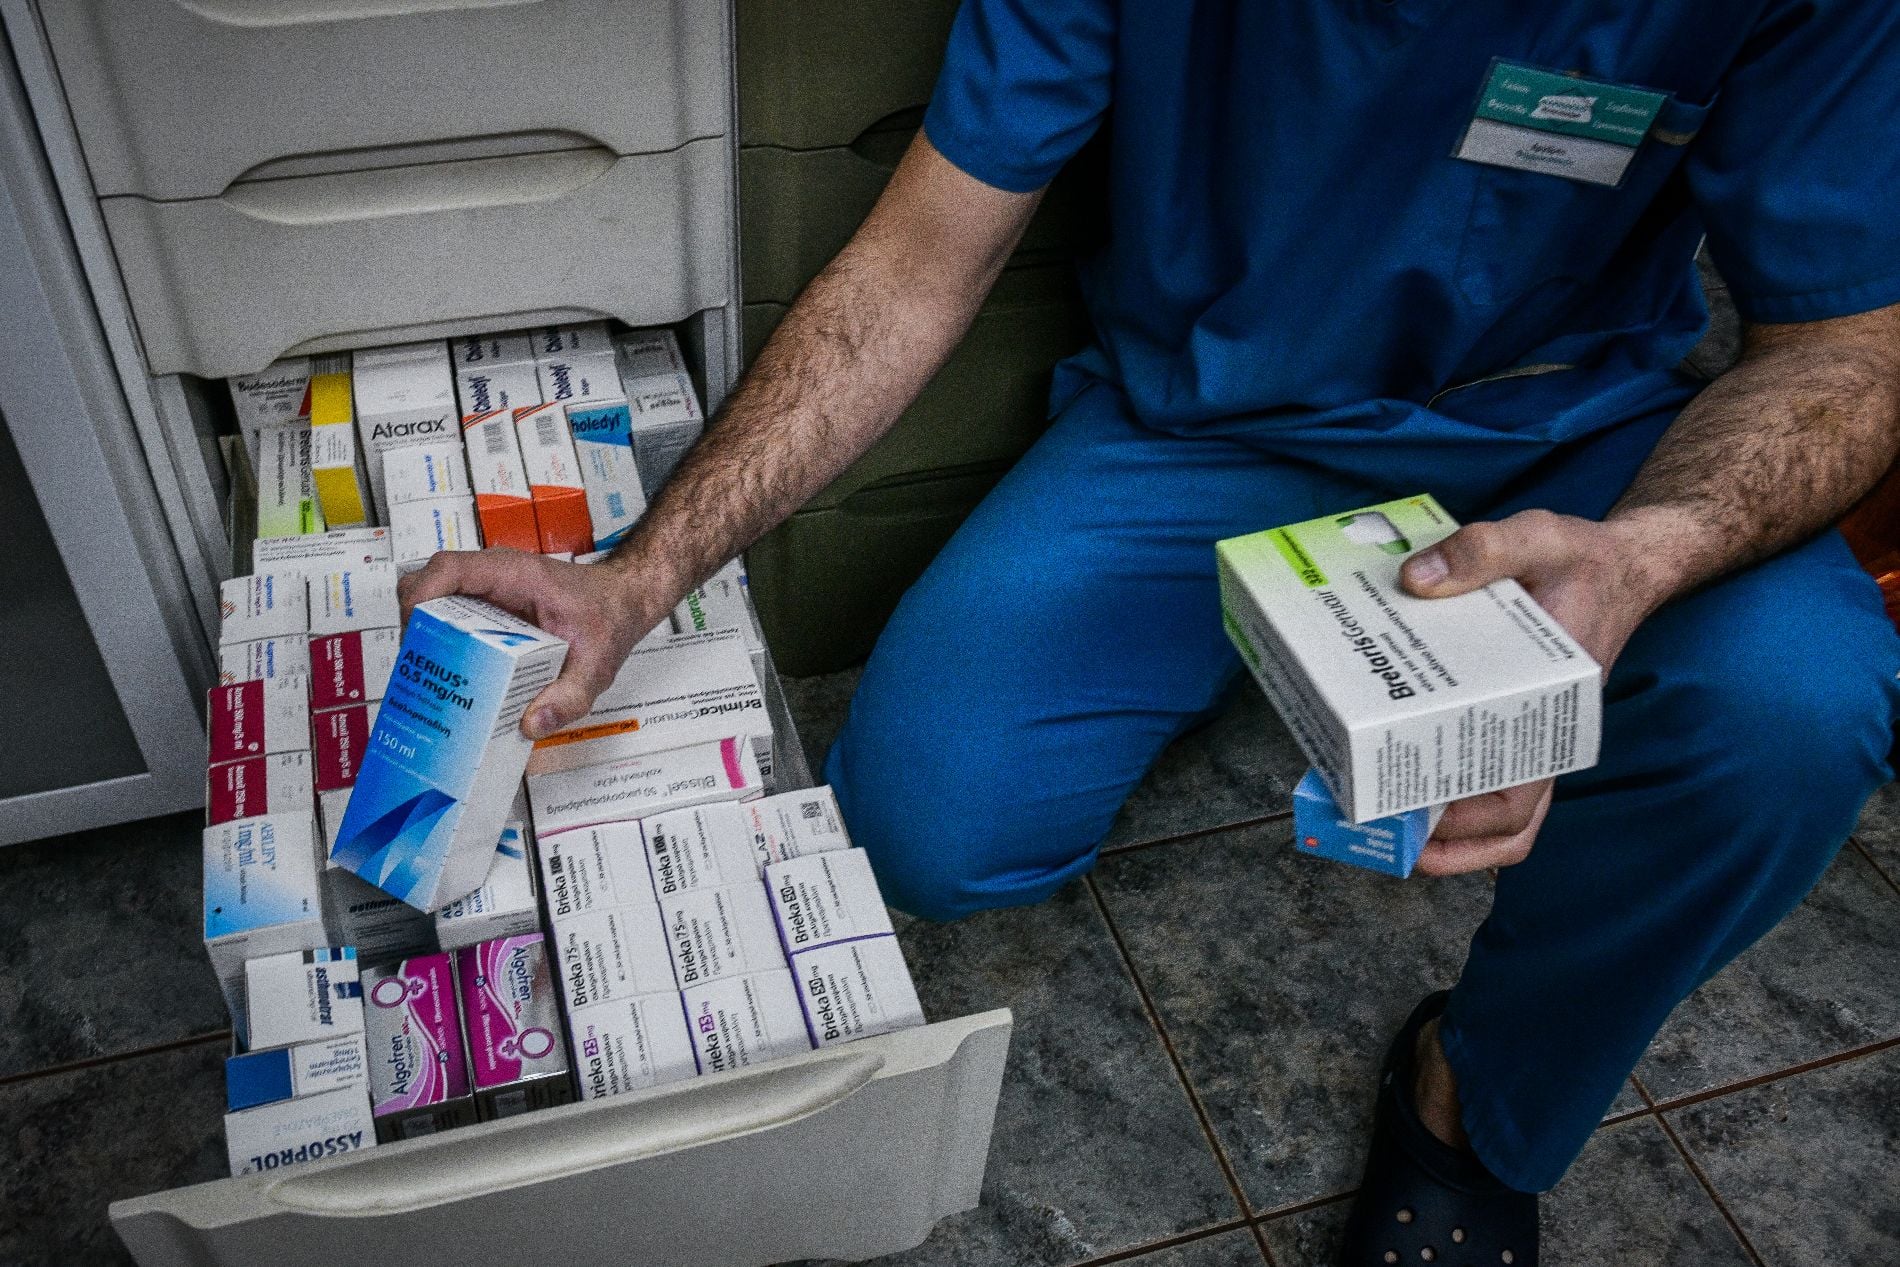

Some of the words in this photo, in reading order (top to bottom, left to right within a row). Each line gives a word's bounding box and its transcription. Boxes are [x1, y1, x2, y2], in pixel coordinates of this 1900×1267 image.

[371, 415, 447, 441] Atarax
[1303, 566, 1324, 585] 322
[402, 648, 463, 688] AERIUS
[1424, 656, 1459, 689] ακλιδίνιο
[397, 662, 422, 684] 0,5
[421, 677, 474, 711] mg/ml
[375, 729, 399, 750] 150
[397, 743, 416, 759] ml
[643, 785, 657, 796] 50
[664, 773, 716, 795] Blissel
[259, 821, 275, 866] ABILIFY
[653, 834, 667, 855] 100
[549, 855, 563, 876] 100
[658, 855, 677, 894] Brieka
[553, 875, 571, 915] Brieka
[780, 886, 796, 903] 50
[676, 924, 686, 939] 75
[788, 903, 808, 943] Brieka
[566, 947, 578, 962] 75
[679, 940, 699, 983] Brieka
[512, 946, 532, 1001] Algofren
[569, 963, 588, 1007] Brieka
[809, 978, 825, 997] 50
[698, 1014, 714, 1033] 25
[818, 996, 839, 1041] Brieka
[584, 1038, 598, 1057] 25
[387, 1035, 409, 1095] Algofren
[250, 1131, 362, 1171] ASSOPROL
